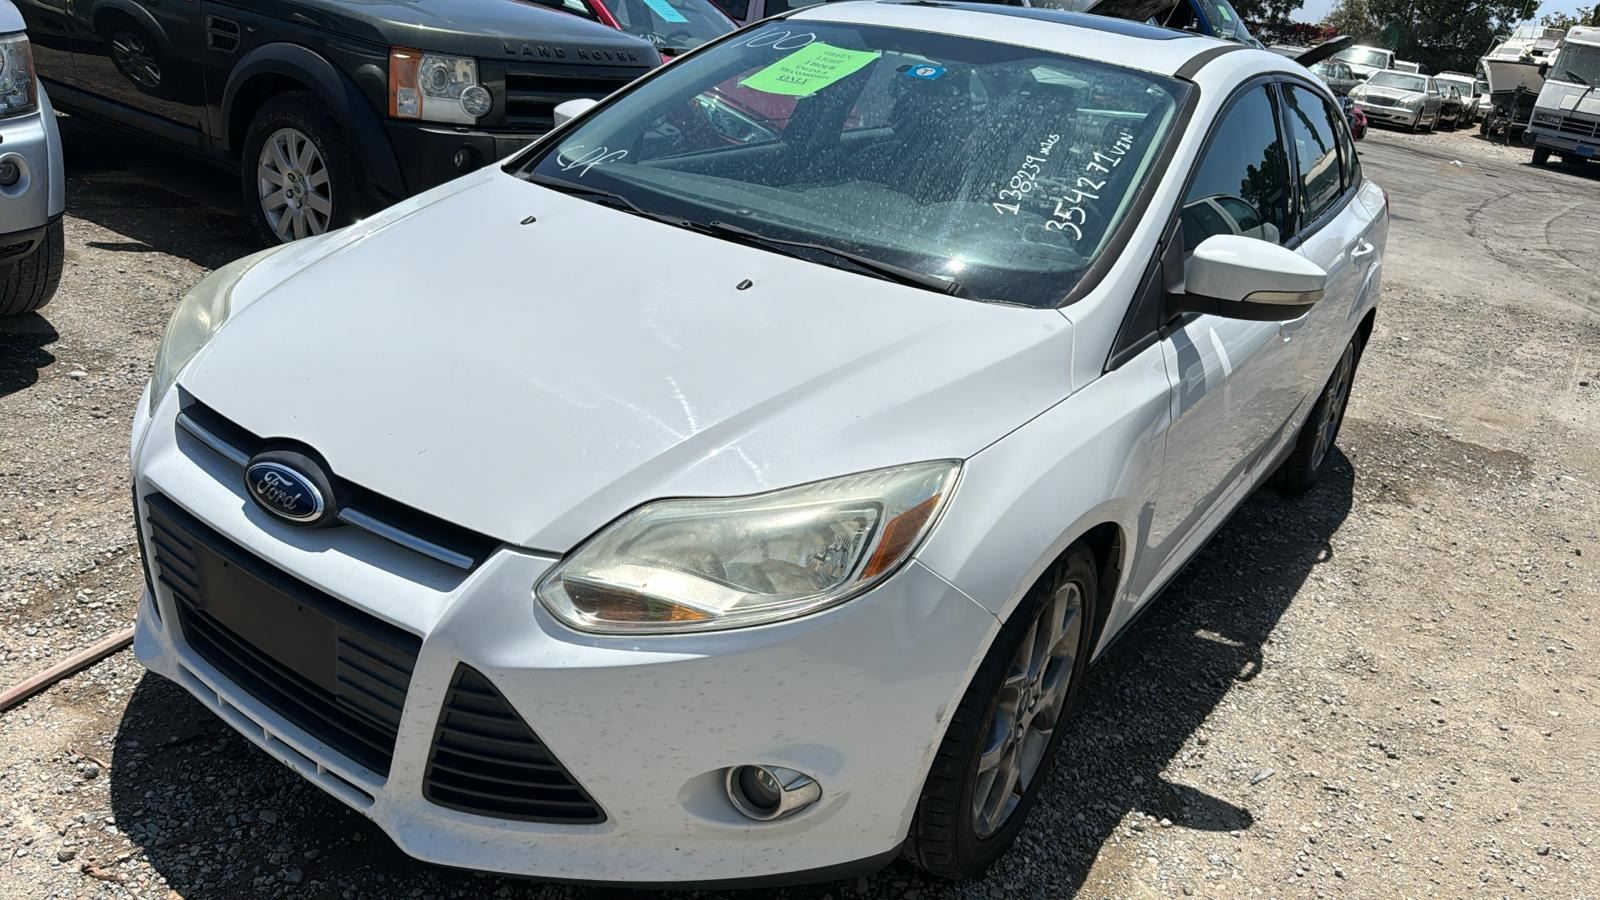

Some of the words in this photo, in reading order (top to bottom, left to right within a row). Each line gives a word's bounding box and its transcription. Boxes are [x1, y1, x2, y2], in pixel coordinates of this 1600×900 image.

[730, 27, 817, 50] 100
[502, 41, 566, 58] LAND
[577, 48, 638, 62] ROVER
[816, 56, 843, 64] LIGHT
[824, 50, 854, 60] GREEN
[776, 74, 808, 84] ONLY
[1109, 132, 1134, 156] VIN
[257, 471, 302, 510] Ford
